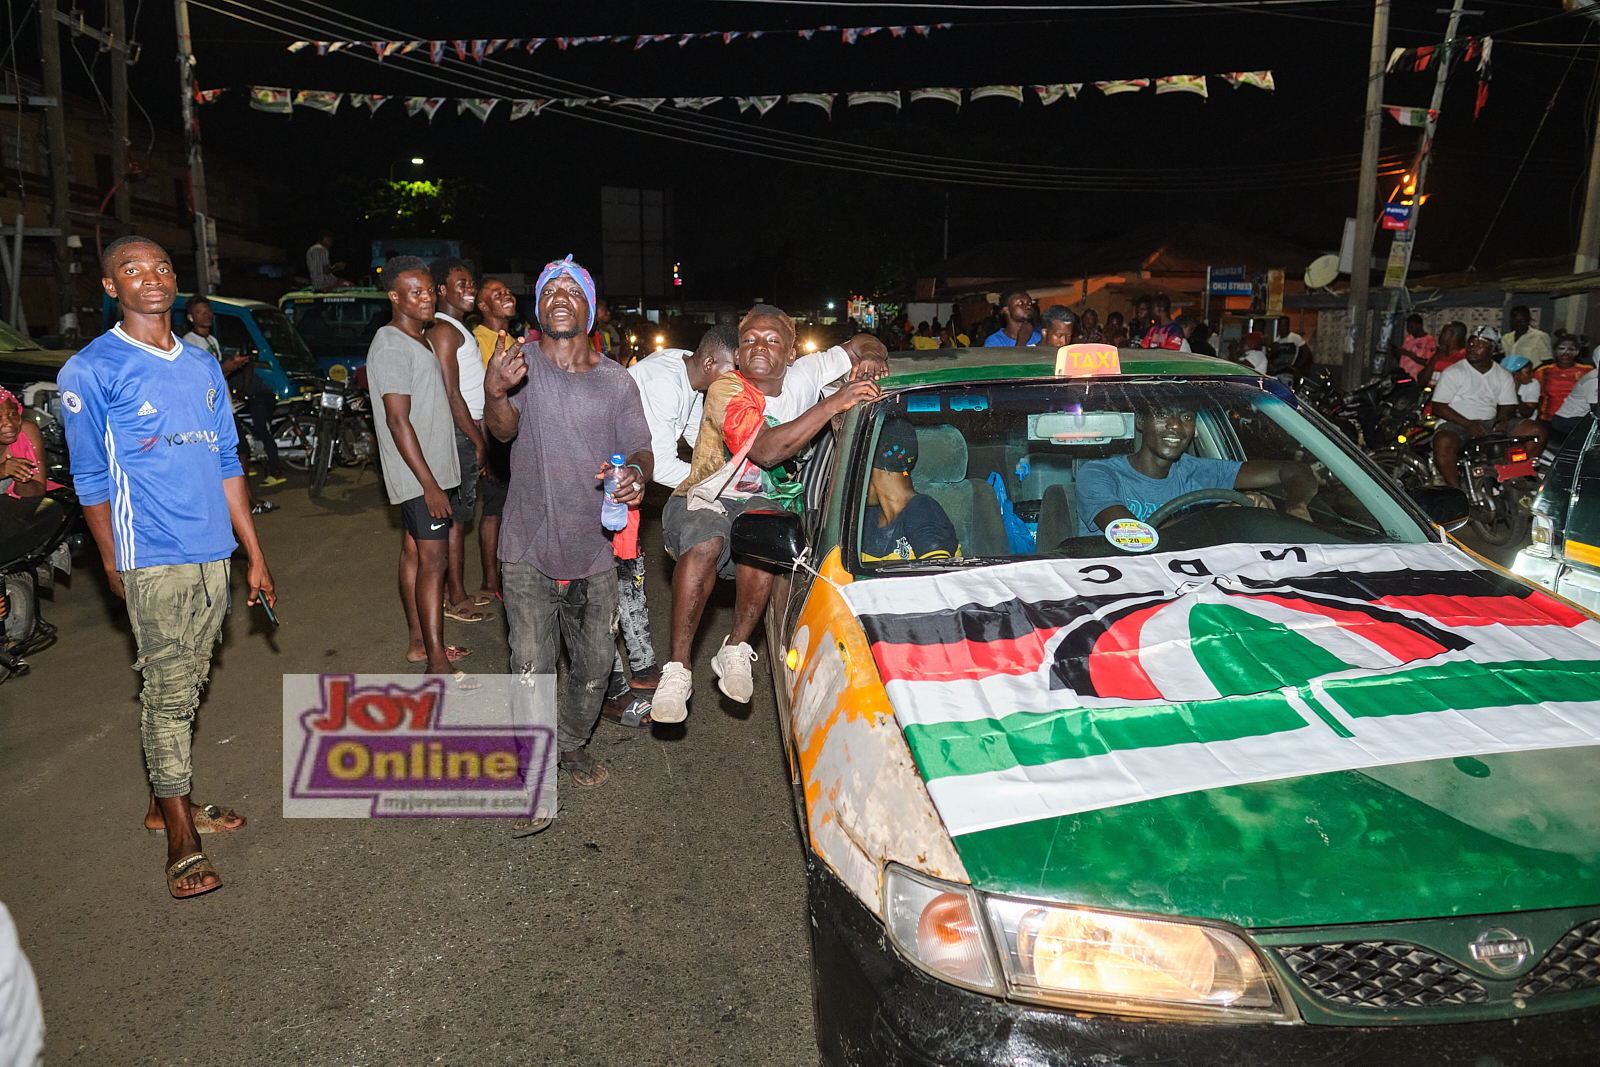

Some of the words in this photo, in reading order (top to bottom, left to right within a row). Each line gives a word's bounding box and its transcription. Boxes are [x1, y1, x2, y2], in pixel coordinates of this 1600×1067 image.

[1212, 282, 1228, 291] OKU
[1228, 282, 1252, 291] STREET
[1069, 351, 1117, 370] TAXI
